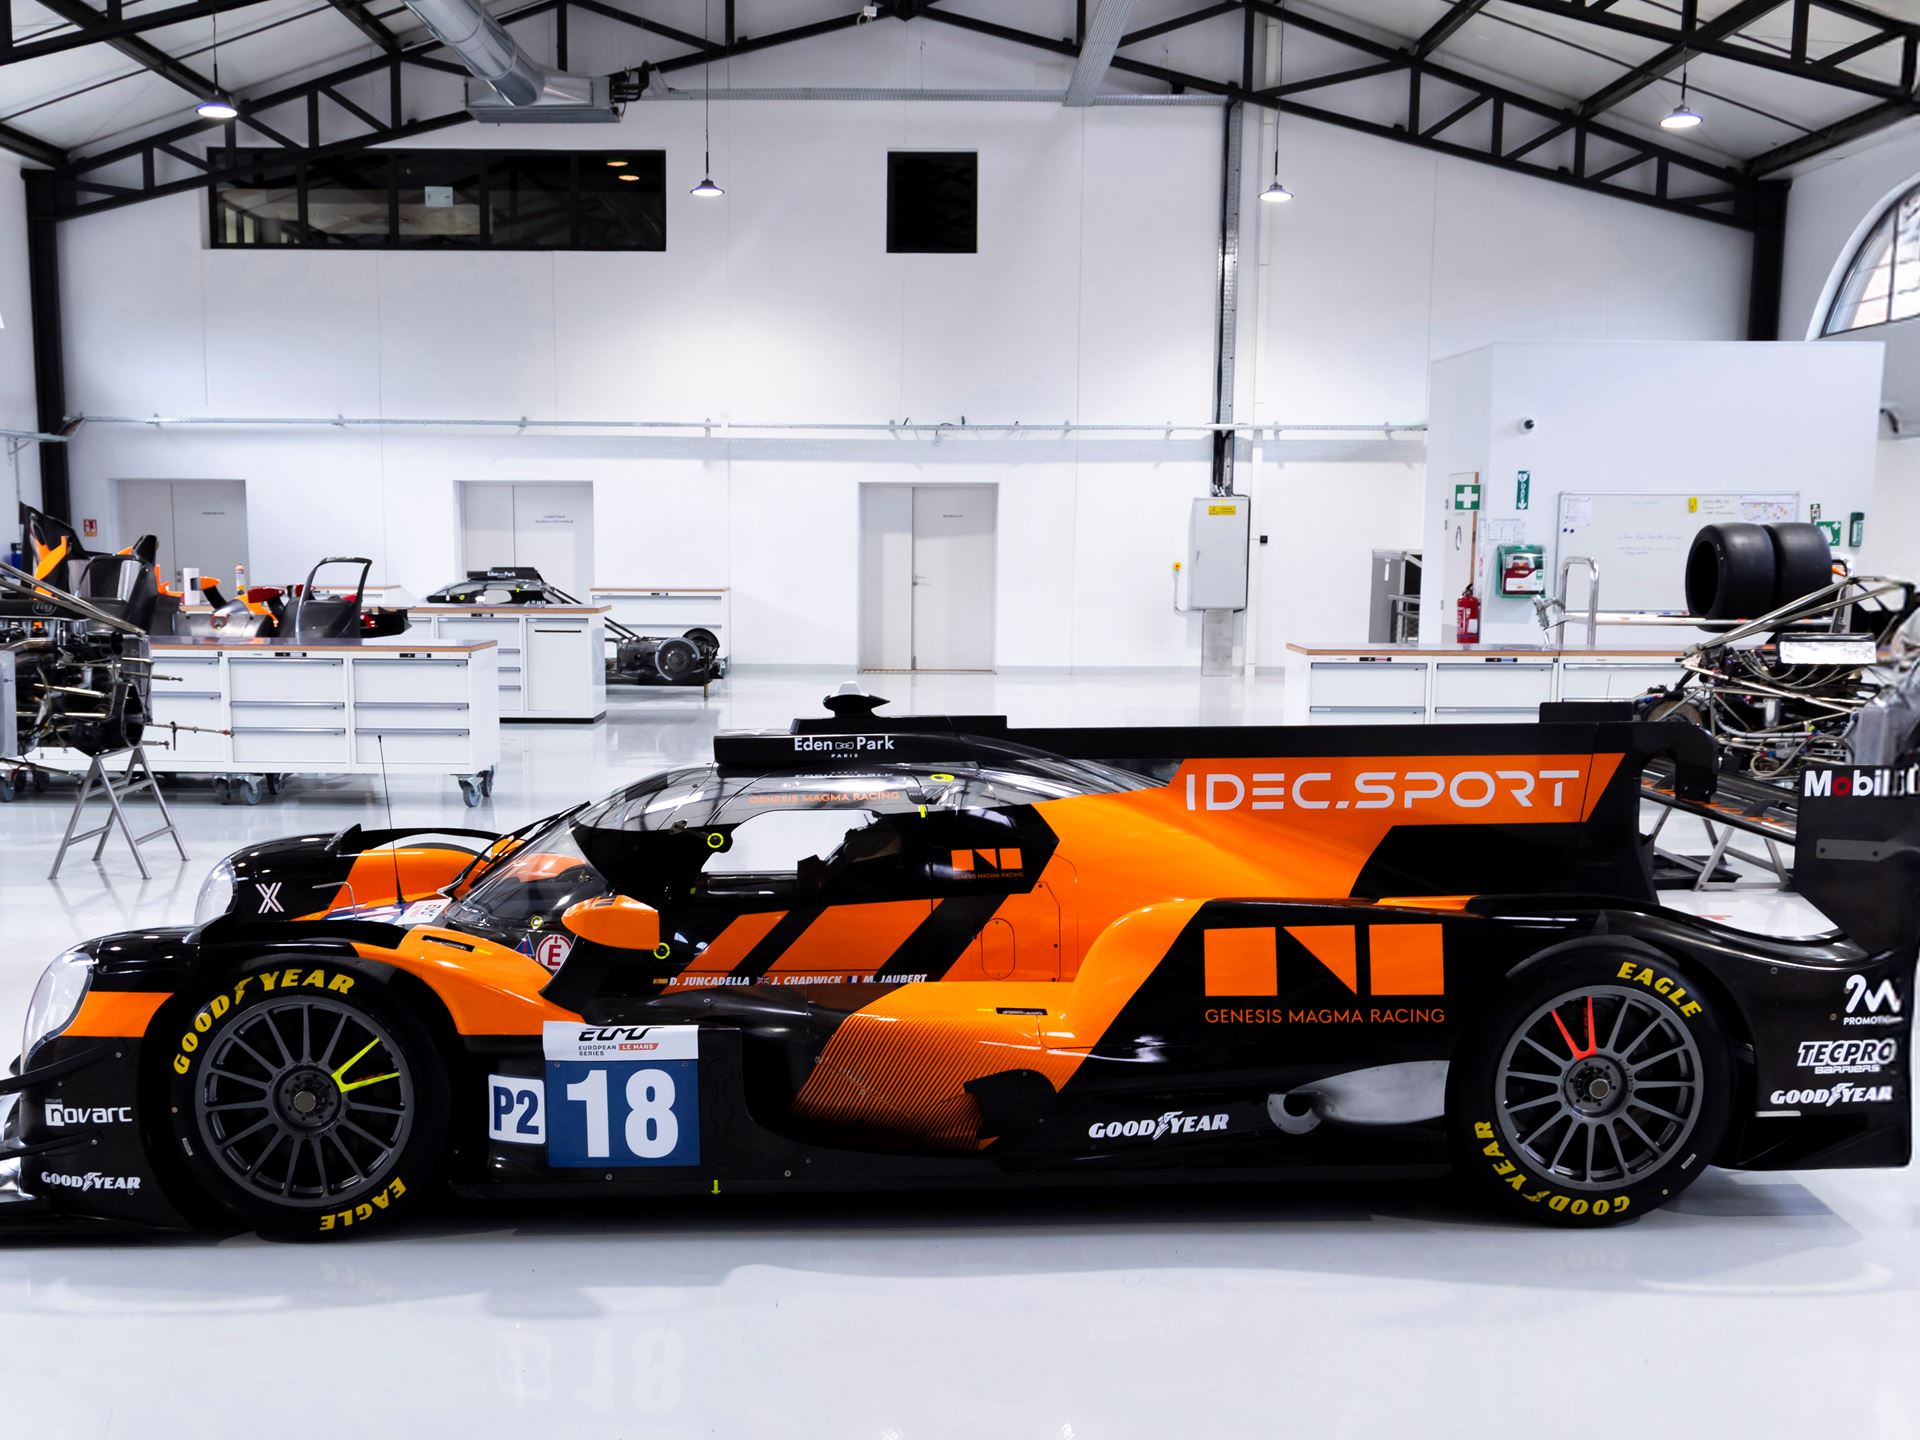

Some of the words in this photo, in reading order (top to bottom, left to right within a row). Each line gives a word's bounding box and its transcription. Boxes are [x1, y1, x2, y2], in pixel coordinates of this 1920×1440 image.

[794, 737, 833, 751] Eden
[856, 735, 895, 750] Park
[749, 794, 798, 804] GENESIS
[801, 793, 849, 802] MAGMA
[852, 791, 900, 801] RACING
[1186, 770, 1580, 811] IDEC.SPORT
[669, 977, 681, 987] D.
[683, 976, 750, 987] JUNCADELLA
[771, 976, 781, 986] J.
[784, 975, 842, 985] CHADWICK
[862, 975, 876, 984] M.
[879, 973, 928, 984] JAUBERT
[1617, 962, 1703, 1017] EAGLE
[1205, 1008, 1282, 1024] GENESIS
[1288, 1009, 1363, 1024] MAGMA
[1370, 1008, 1445, 1023] RACING
[621, 1043, 631, 1051] LE
[1796, 1038, 1897, 1065] TECPRO
[493, 1085, 540, 1135] P2
[565, 1068, 680, 1159] 18
[320, 1177, 407, 1231] EAGLE
